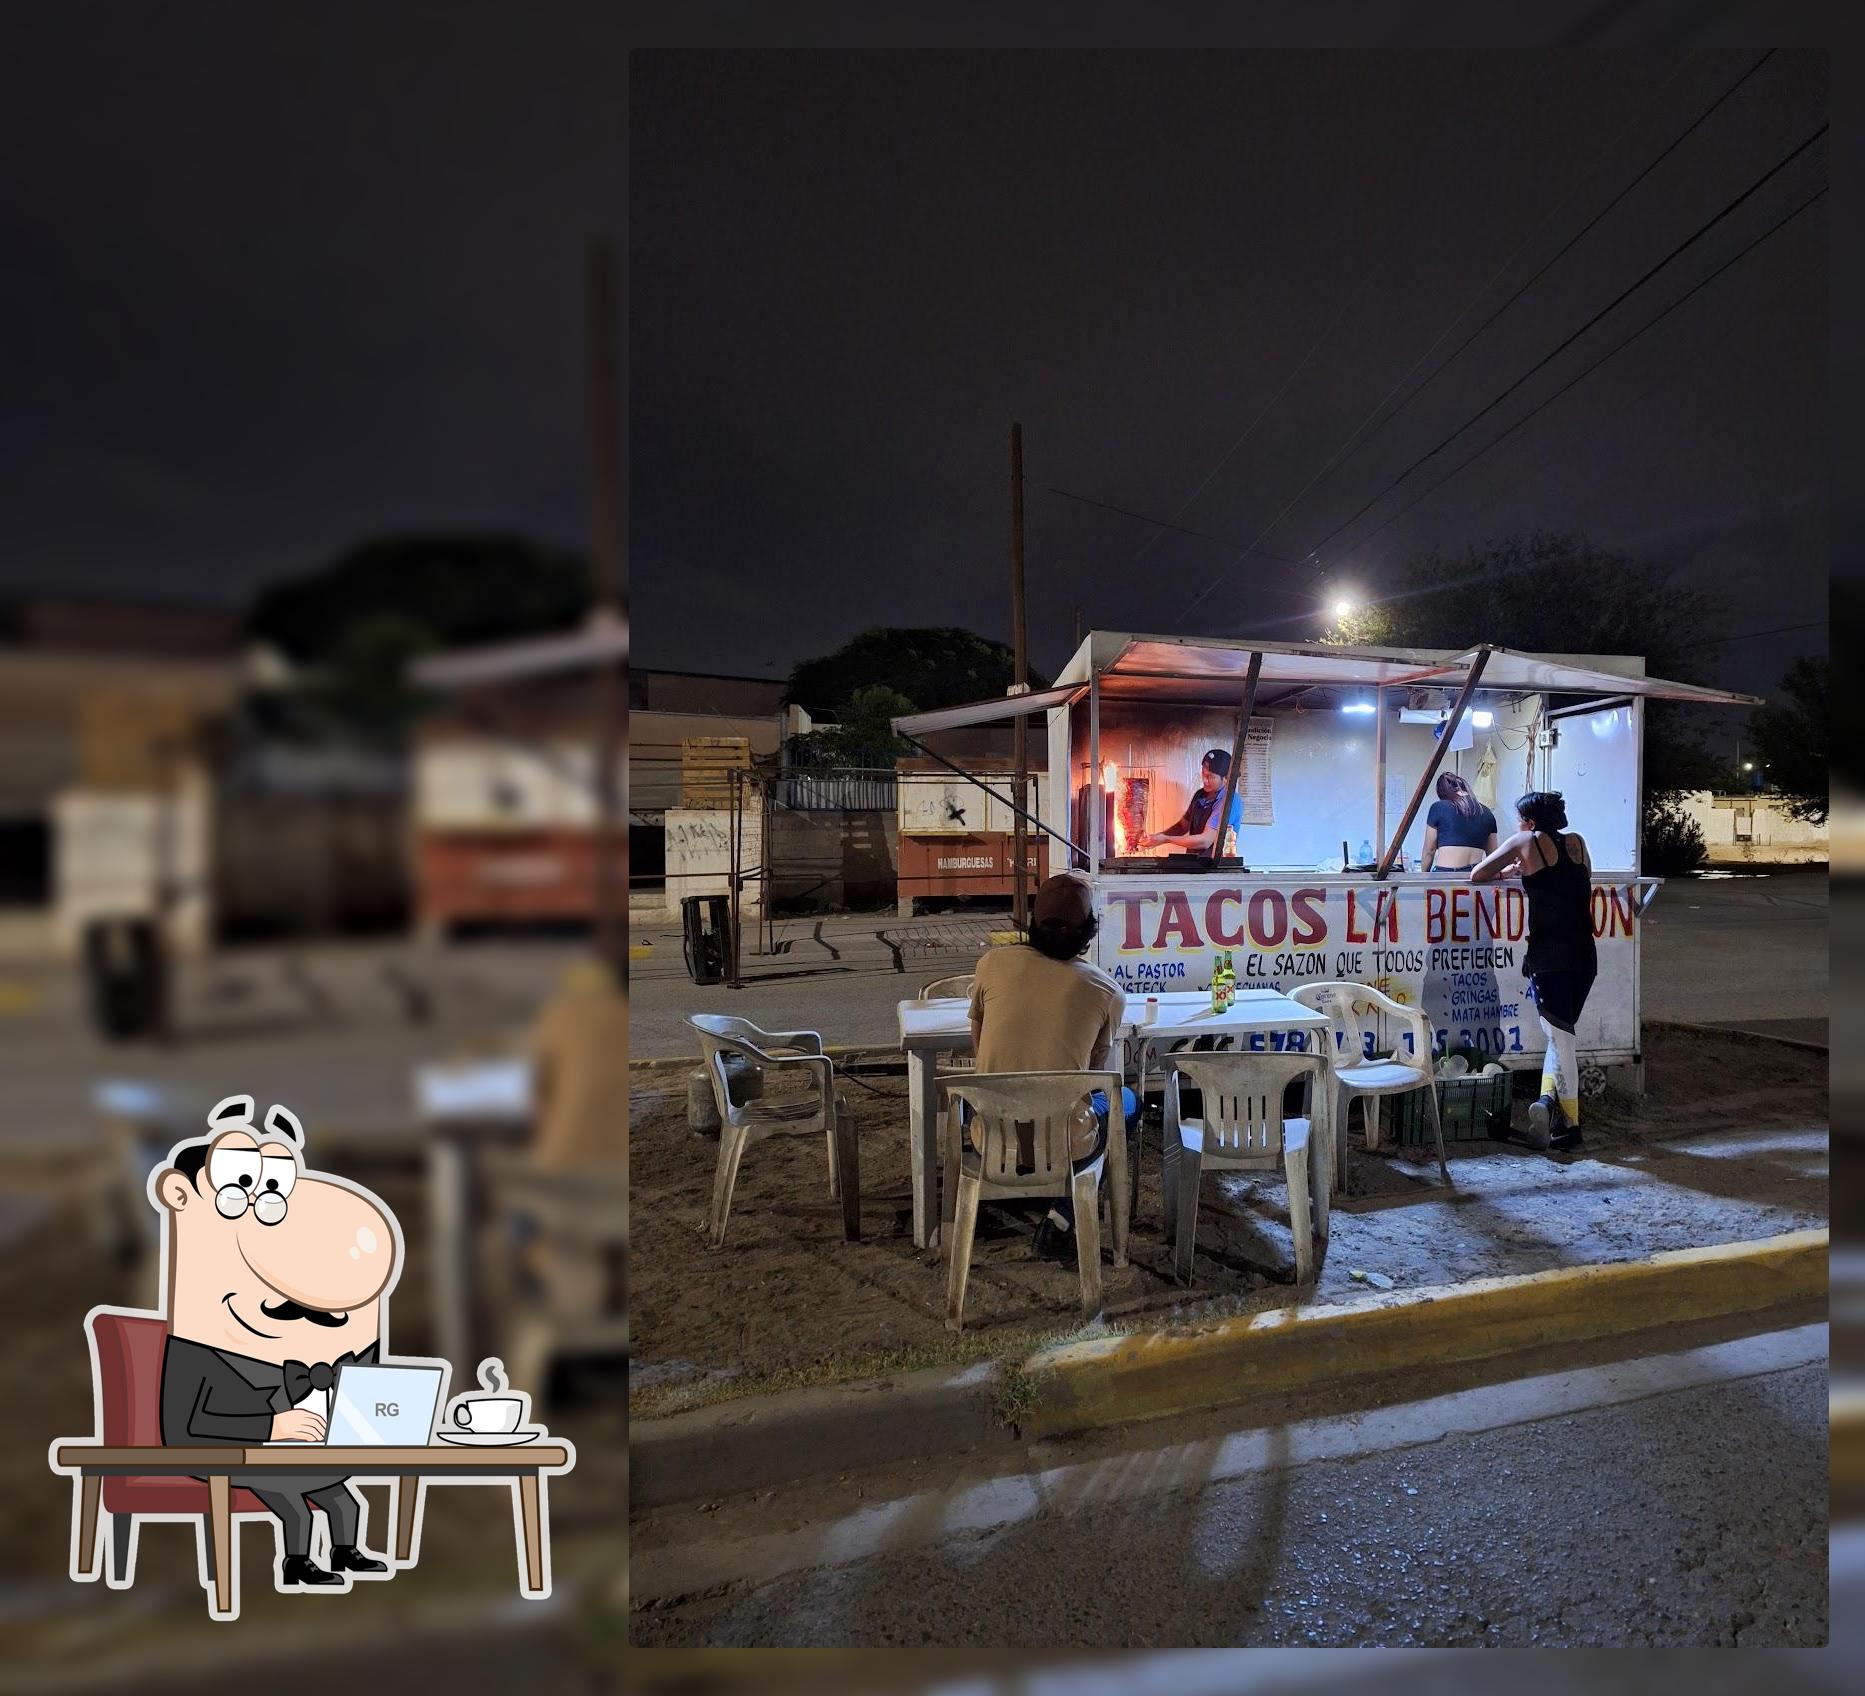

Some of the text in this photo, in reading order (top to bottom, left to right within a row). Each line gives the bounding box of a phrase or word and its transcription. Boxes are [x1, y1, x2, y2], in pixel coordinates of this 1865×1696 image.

[937, 857, 994, 870] HAMBURGUESAS
[1106, 888, 1329, 953] TACOS
[1345, 888, 1399, 944] LA
[1114, 962, 1186, 980] AL PASTOR
[1246, 947, 1515, 978] EL SAZON QUE TODOS PREFIEREN
[1451, 972, 1487, 987] TACOS
[1451, 988, 1498, 1006] GRINGAS
[1452, 1003, 1519, 1023] MATA HAMBRE
